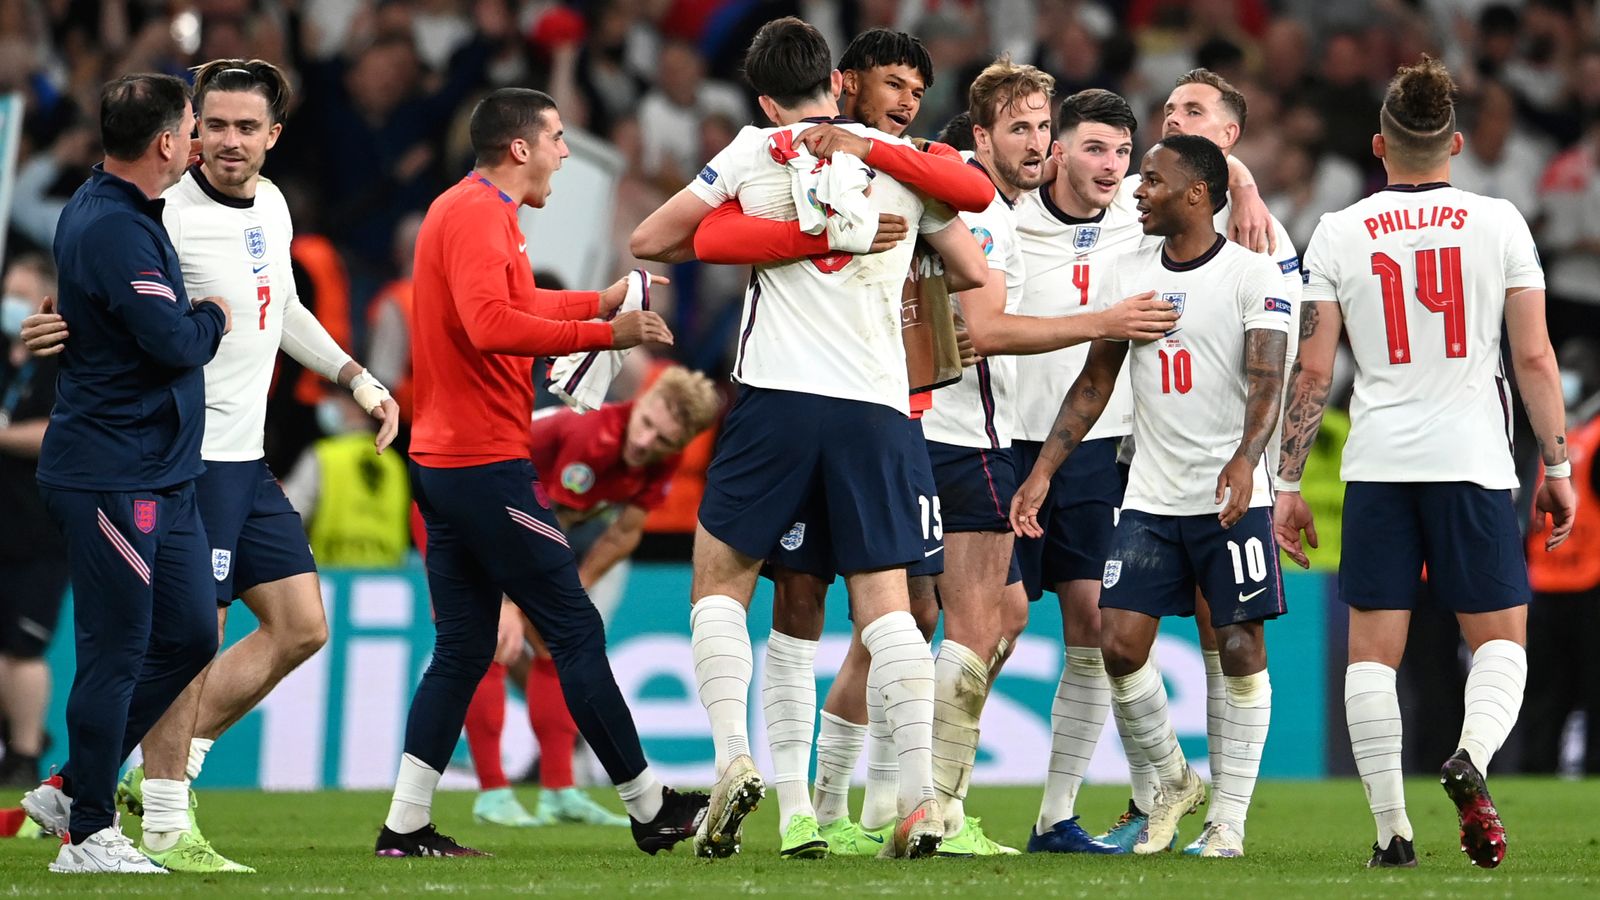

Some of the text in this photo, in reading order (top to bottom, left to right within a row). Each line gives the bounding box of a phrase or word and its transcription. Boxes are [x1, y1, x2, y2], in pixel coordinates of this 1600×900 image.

[1364, 206, 1468, 240] PHILLIPS
[257, 286, 271, 331] 7
[1072, 264, 1090, 306] 4
[1371, 247, 1467, 365] 14
[1158, 348, 1193, 395] 10
[918, 494, 944, 541] 15
[1227, 536, 1268, 585] 10
